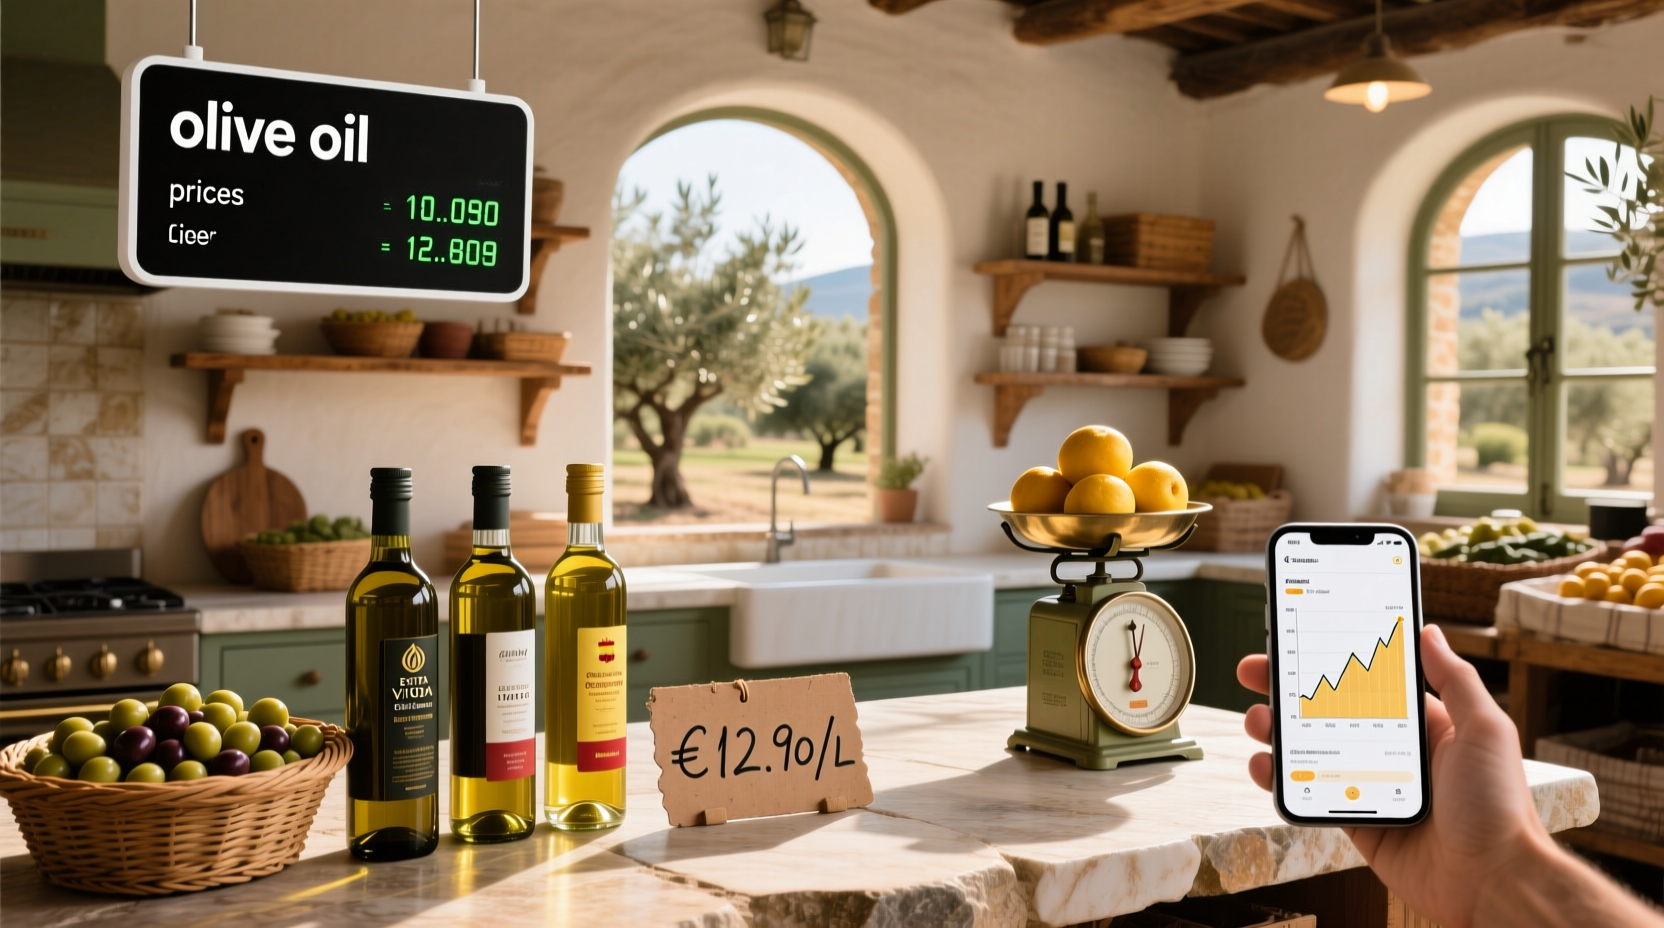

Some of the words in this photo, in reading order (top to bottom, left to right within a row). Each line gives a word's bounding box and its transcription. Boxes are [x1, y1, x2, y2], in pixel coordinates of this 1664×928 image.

[170, 100, 296, 157] olive
[310, 112, 369, 163] oil
[169, 179, 244, 209] prices
[671, 715, 856, 781] €12.90/L
